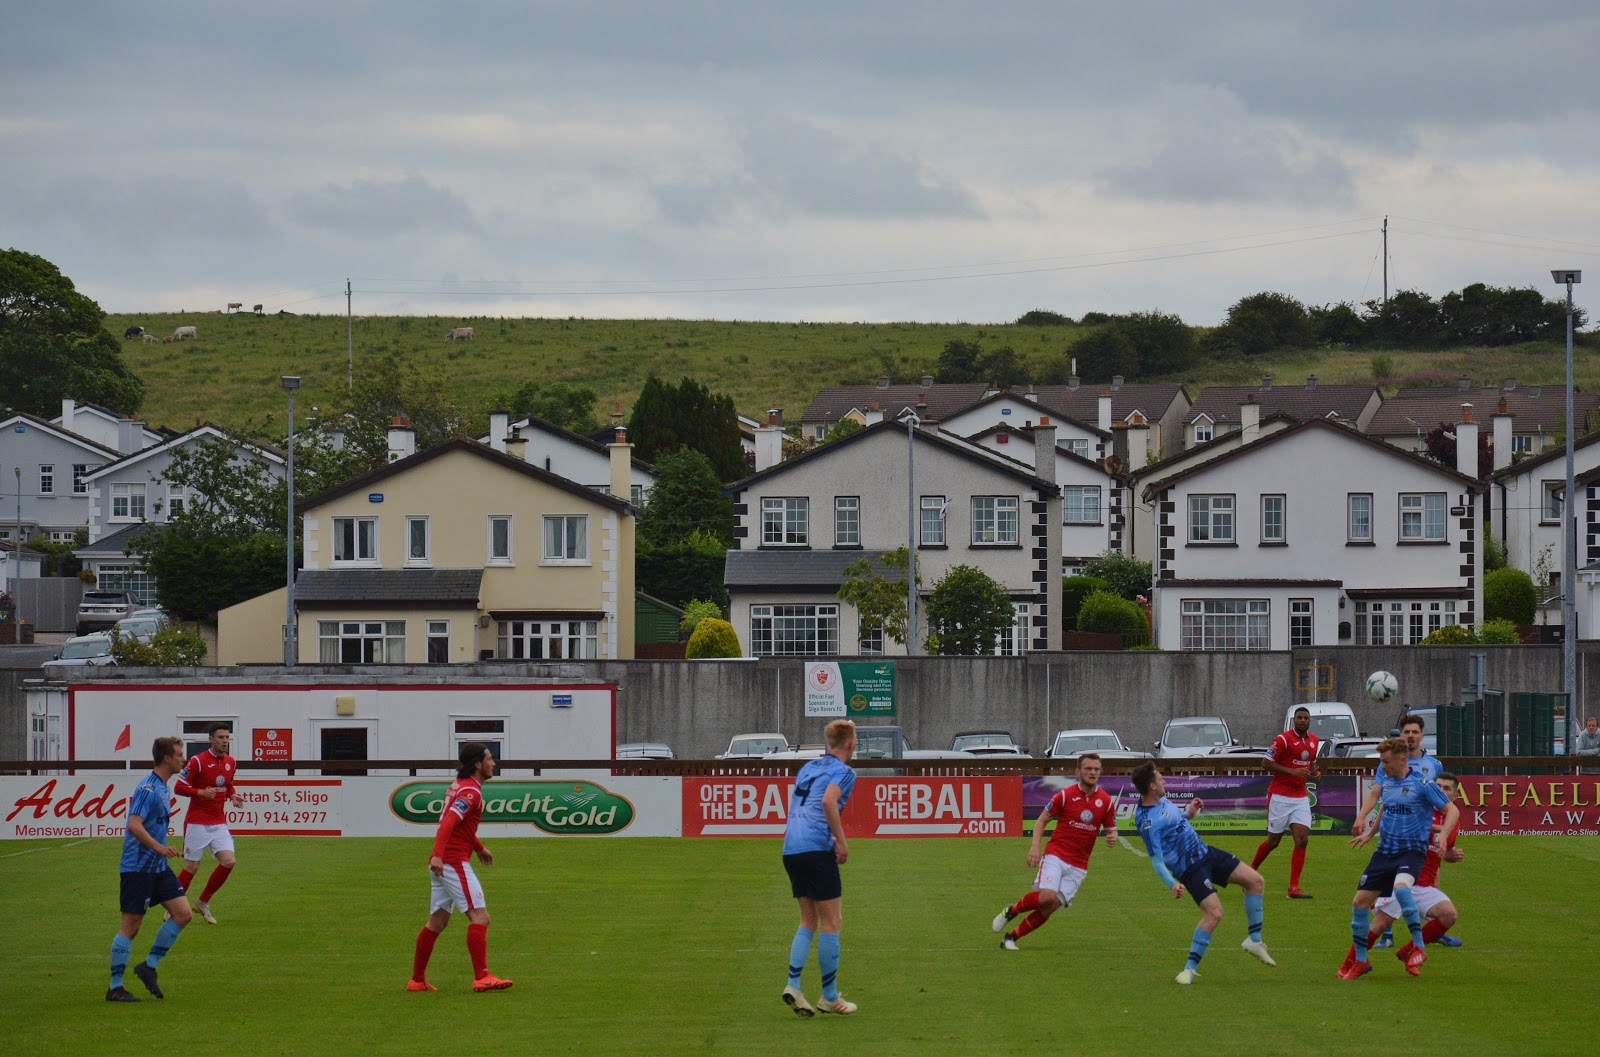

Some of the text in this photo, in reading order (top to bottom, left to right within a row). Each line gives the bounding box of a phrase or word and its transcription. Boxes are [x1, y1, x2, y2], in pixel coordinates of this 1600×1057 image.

[273, 790, 291, 805] St,
[295, 790, 329, 806] Sligo
[700, 784, 733, 801] OFF
[794, 775, 816, 807] 4
[875, 784, 908, 801] OFF
[403, 790, 554, 815] Coacht
[735, 784, 796, 820] BA
[910, 783, 1005, 819] BALL
[225, 811, 327, 826] (071) 914 2977
[545, 805, 617, 826] Gold
[700, 802, 733, 820] THE
[875, 802, 908, 819] THE
[15, 824, 85, 836] Menswear
[963, 820, 1006, 834] .com
